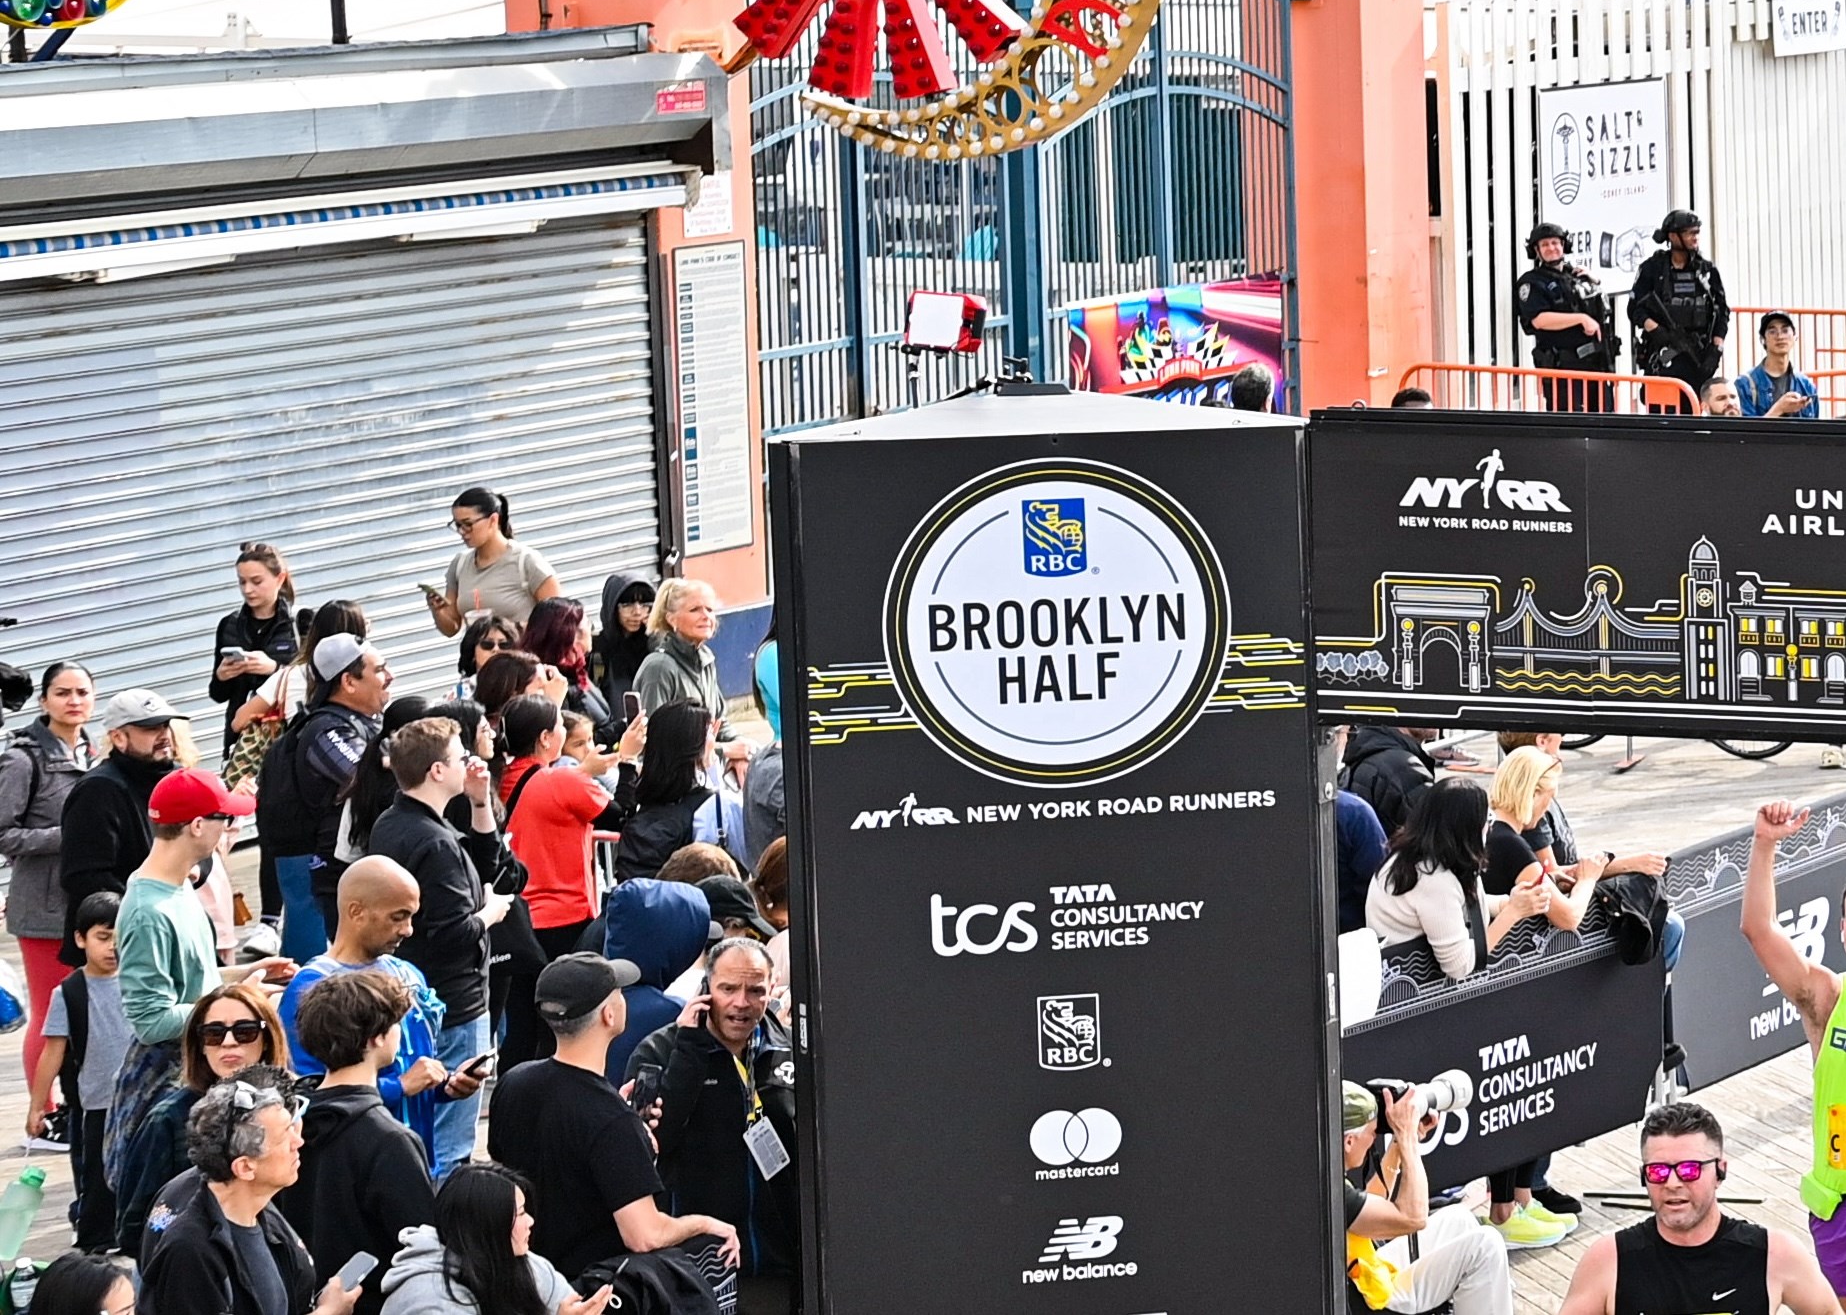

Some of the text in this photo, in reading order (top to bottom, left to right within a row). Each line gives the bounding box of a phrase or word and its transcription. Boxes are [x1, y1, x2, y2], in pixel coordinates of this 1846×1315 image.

[1792, 10, 1828, 35] ENTER
[1585, 111, 1632, 143] SALT
[1586, 143, 1657, 178] SIZZLE
[1399, 477, 1573, 513] NYRR
[1399, 516, 1573, 533] NEW YORK ROAD RUNNERS
[1031, 553, 1082, 572] RBC
[928, 592, 1187, 652] BROOKLYN
[998, 651, 1120, 705] HALF
[850, 790, 1276, 831] NYRR NEW YORK ROAD RUNNERS
[1050, 884, 1116, 905] TATA
[930, 893, 1038, 956] tcs
[1050, 901, 1204, 928] CONSULTANCY
[1051, 927, 1150, 951] SERVICES
[1750, 1004, 1780, 1040] new
[1046, 1046, 1093, 1065] RBC
[1478, 1034, 1531, 1071] TATA
[1479, 1042, 1597, 1103] CONSULTANCY
[1480, 1088, 1555, 1136] SERVICES
[1830, 1134, 1841, 1153] C
[1035, 1162, 1120, 1181] mastercard
[1038, 1215, 1124, 1263] NB
[1022, 1261, 1138, 1284] new balance
